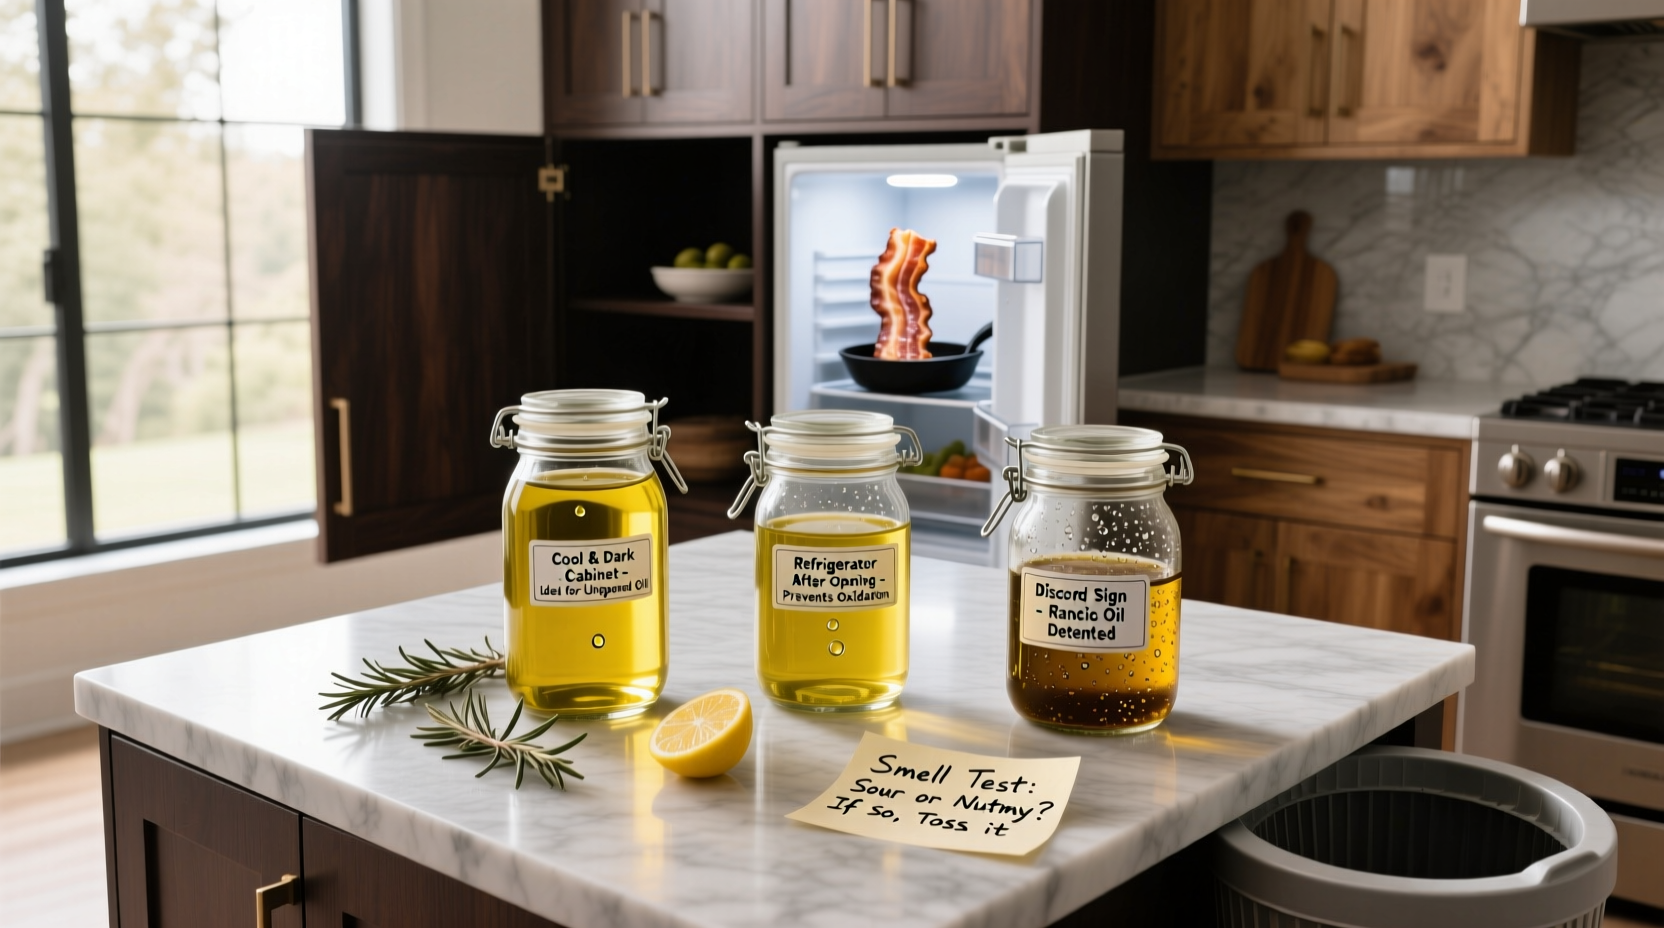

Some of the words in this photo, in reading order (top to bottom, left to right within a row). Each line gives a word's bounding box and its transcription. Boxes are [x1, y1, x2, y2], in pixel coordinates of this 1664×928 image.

[552, 551, 583, 565] Cool
[588, 551, 599, 565] &
[603, 547, 635, 564] Dark
[794, 556, 878, 575] Refrigerator
[565, 567, 619, 582] Cabinet
[565, 585, 582, 596] for
[1035, 582, 1088, 602] Discord
[1094, 587, 1127, 607] Sign
[1103, 607, 1125, 623] Oil
[1048, 622, 1116, 641] Detented
[869, 754, 952, 784] Smell
[968, 768, 1036, 794] Test:
[850, 778, 905, 799] Sour
[915, 793, 942, 804] or
[826, 796, 863, 815] If
[917, 811, 968, 832] Toss
[984, 822, 1010, 837] it
